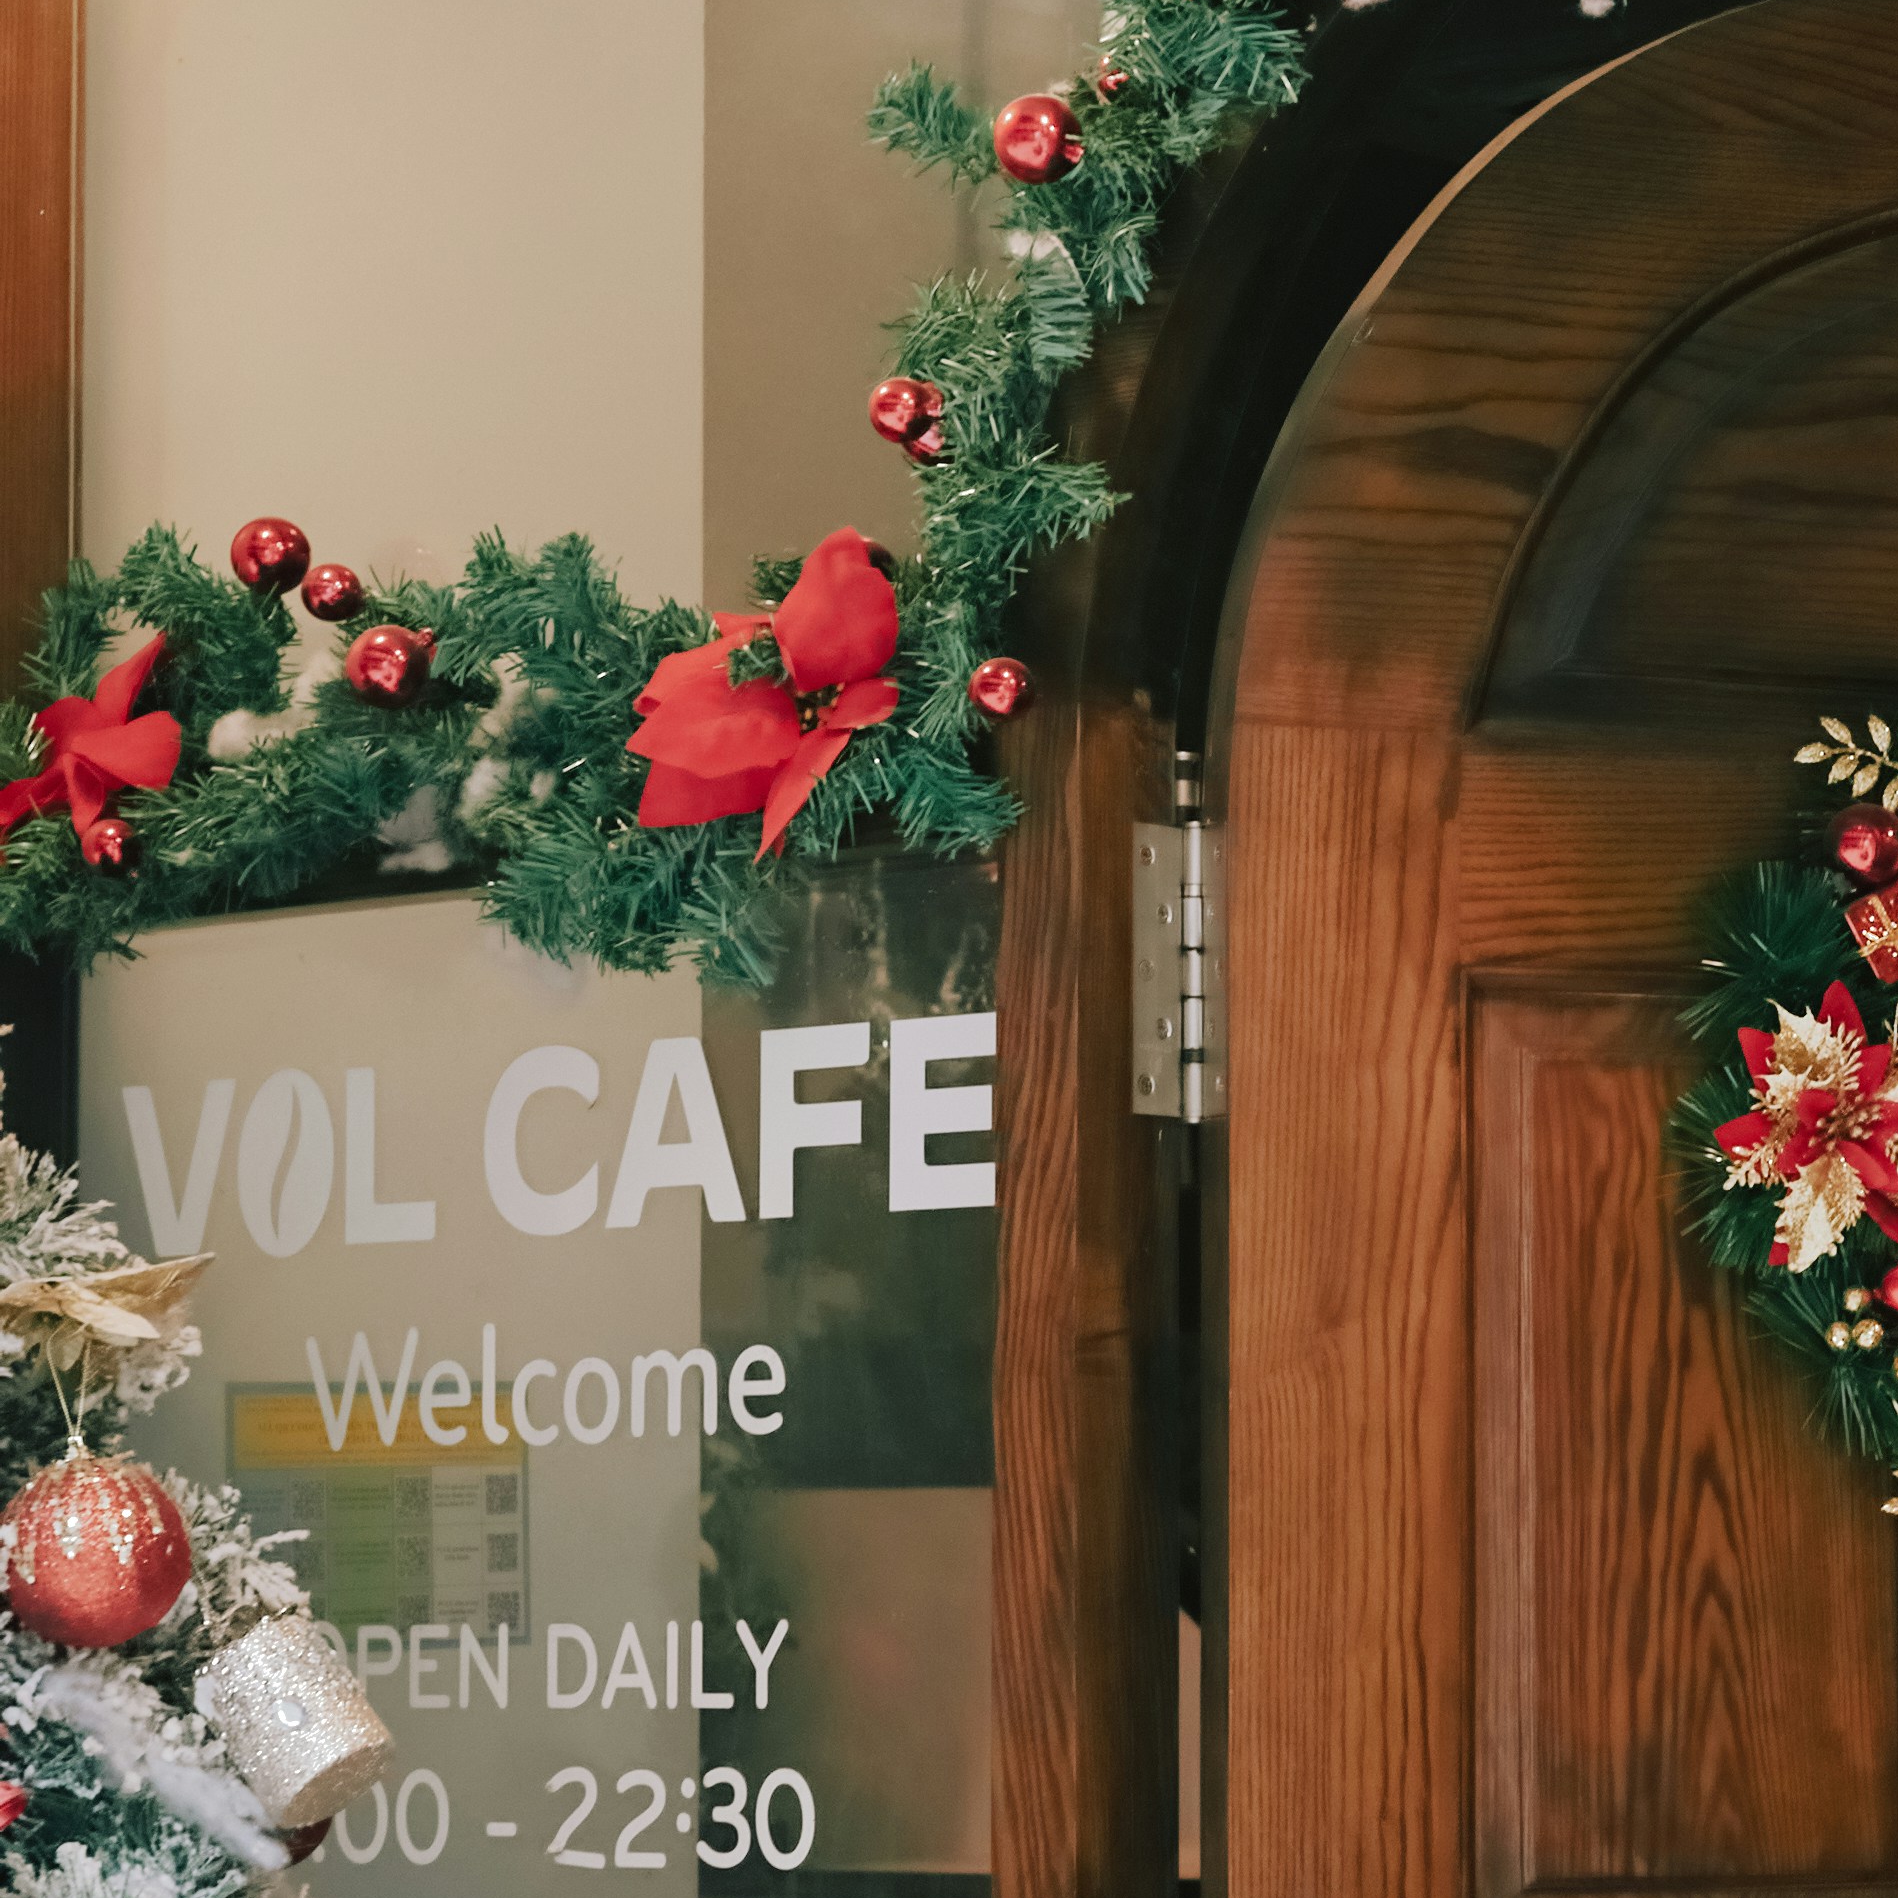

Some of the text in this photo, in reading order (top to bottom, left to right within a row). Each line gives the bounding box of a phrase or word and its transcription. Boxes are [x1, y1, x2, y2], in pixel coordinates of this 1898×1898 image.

[122, 1011, 997, 1259] VOL CAFE
[305, 1322, 786, 1452] Welcome
[546, 1618, 790, 1710] DAILY
[544, 1765, 816, 1871] 22:30
